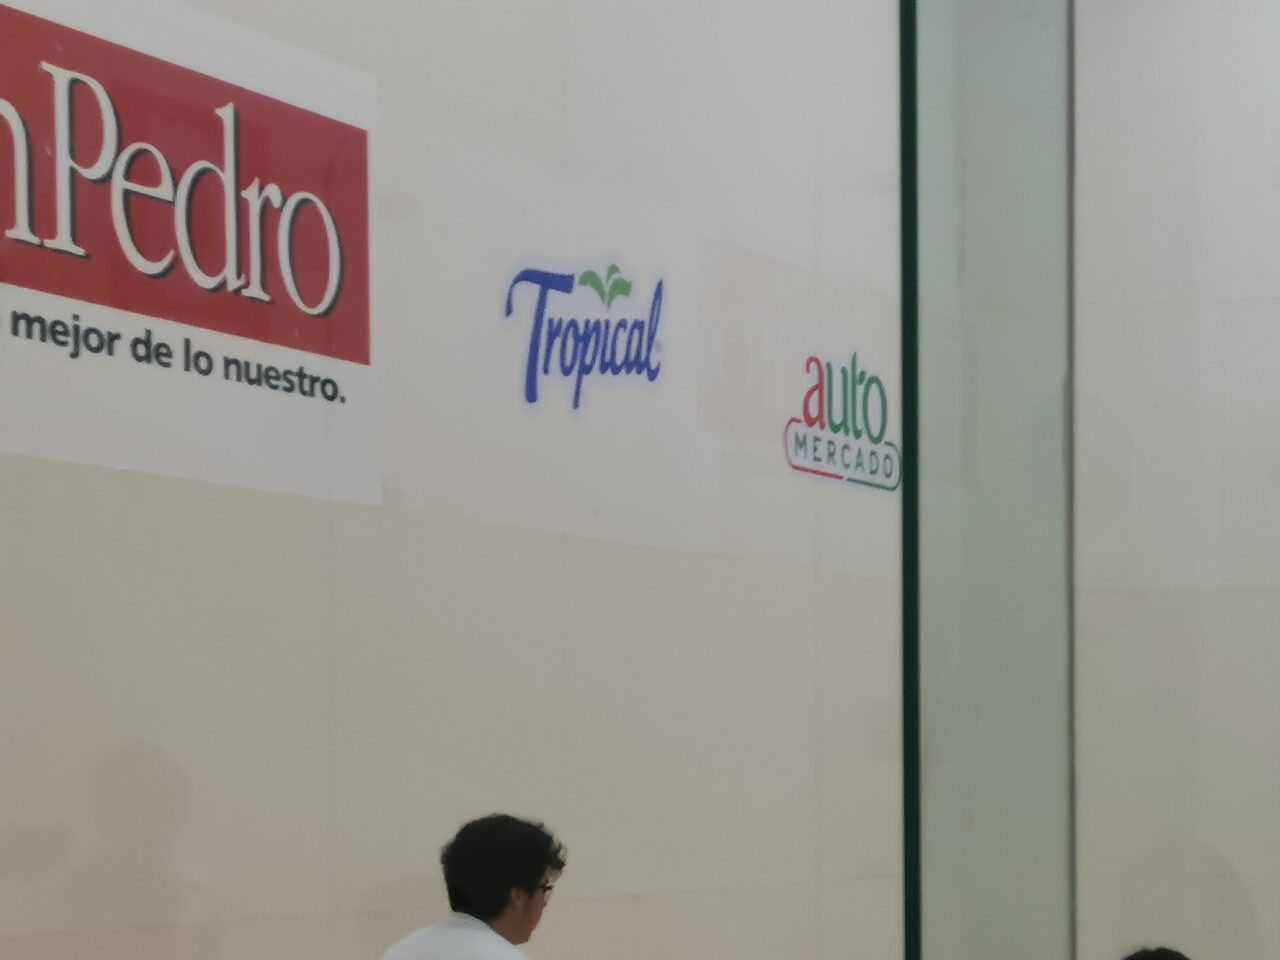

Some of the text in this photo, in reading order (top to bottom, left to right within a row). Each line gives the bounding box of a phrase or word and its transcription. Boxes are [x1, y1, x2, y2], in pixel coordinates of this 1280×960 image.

[11, 308, 346, 403] mejor de lo nuestro.
[505, 268, 664, 410] Tropical
[803, 351, 888, 445] auto
[794, 431, 894, 480] MERCADO
